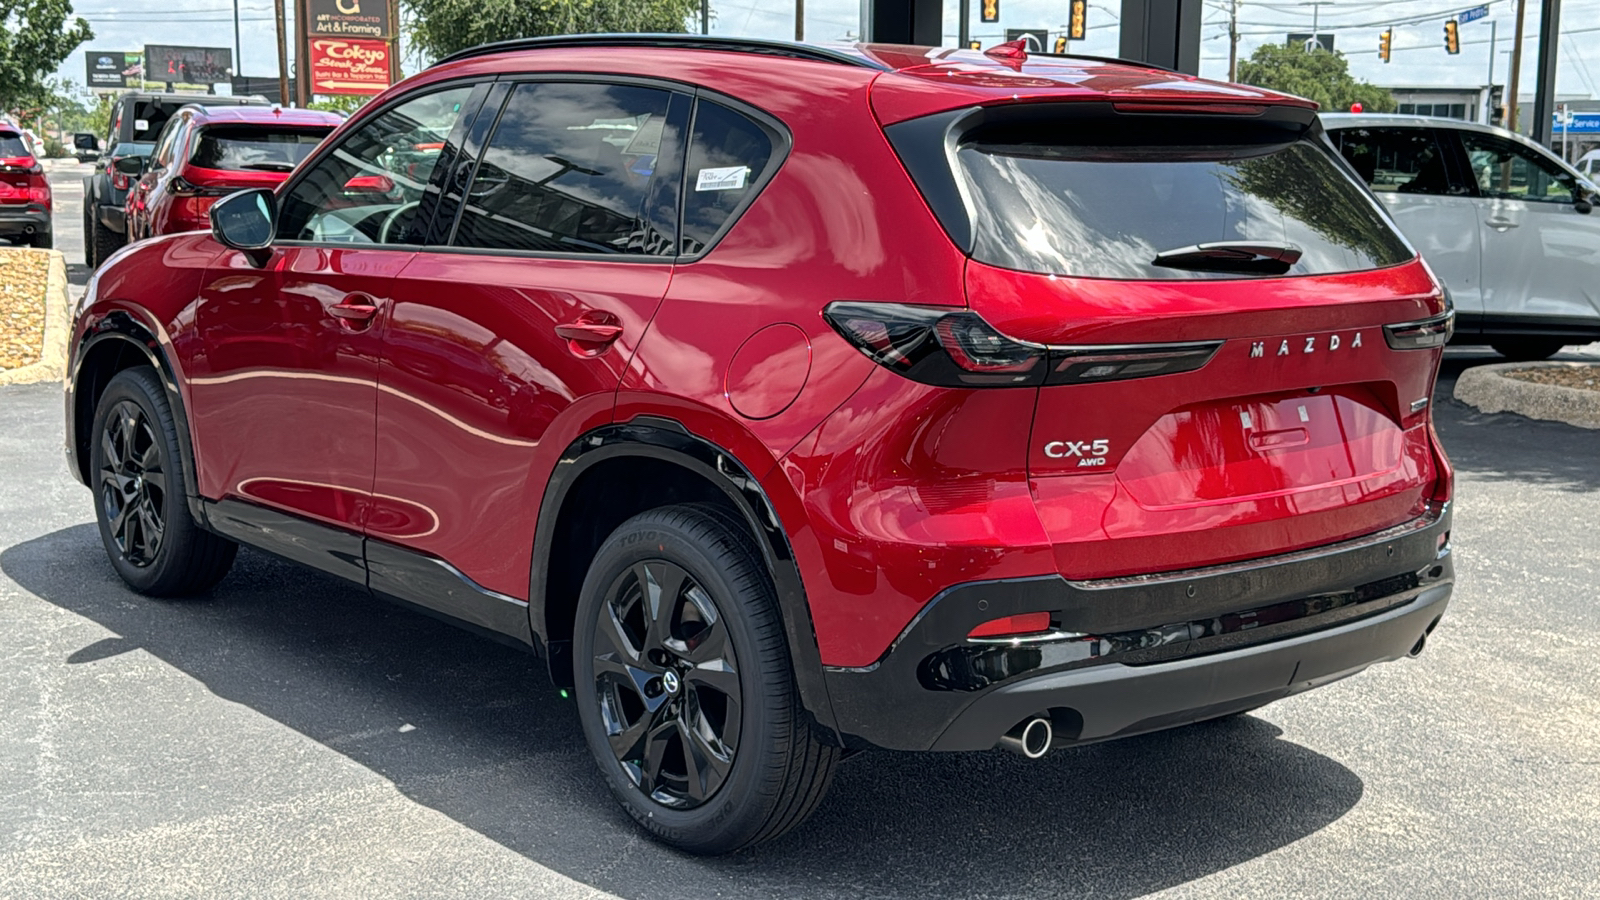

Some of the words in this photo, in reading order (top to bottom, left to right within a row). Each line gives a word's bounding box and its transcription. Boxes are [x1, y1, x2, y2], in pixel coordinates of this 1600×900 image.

[331, 15, 380, 23] INCORPORATED
[317, 22, 332, 32] Art
[333, 22, 341, 32] &
[342, 22, 381, 37] Framing
[314, 40, 385, 65] Tokyo
[314, 58, 353, 69] Steak
[1573, 119, 1600, 128] Service
[1249, 332, 1362, 358] MAZDA
[1044, 438, 1109, 458] CX-5
[1077, 457, 1106, 467] AWD
